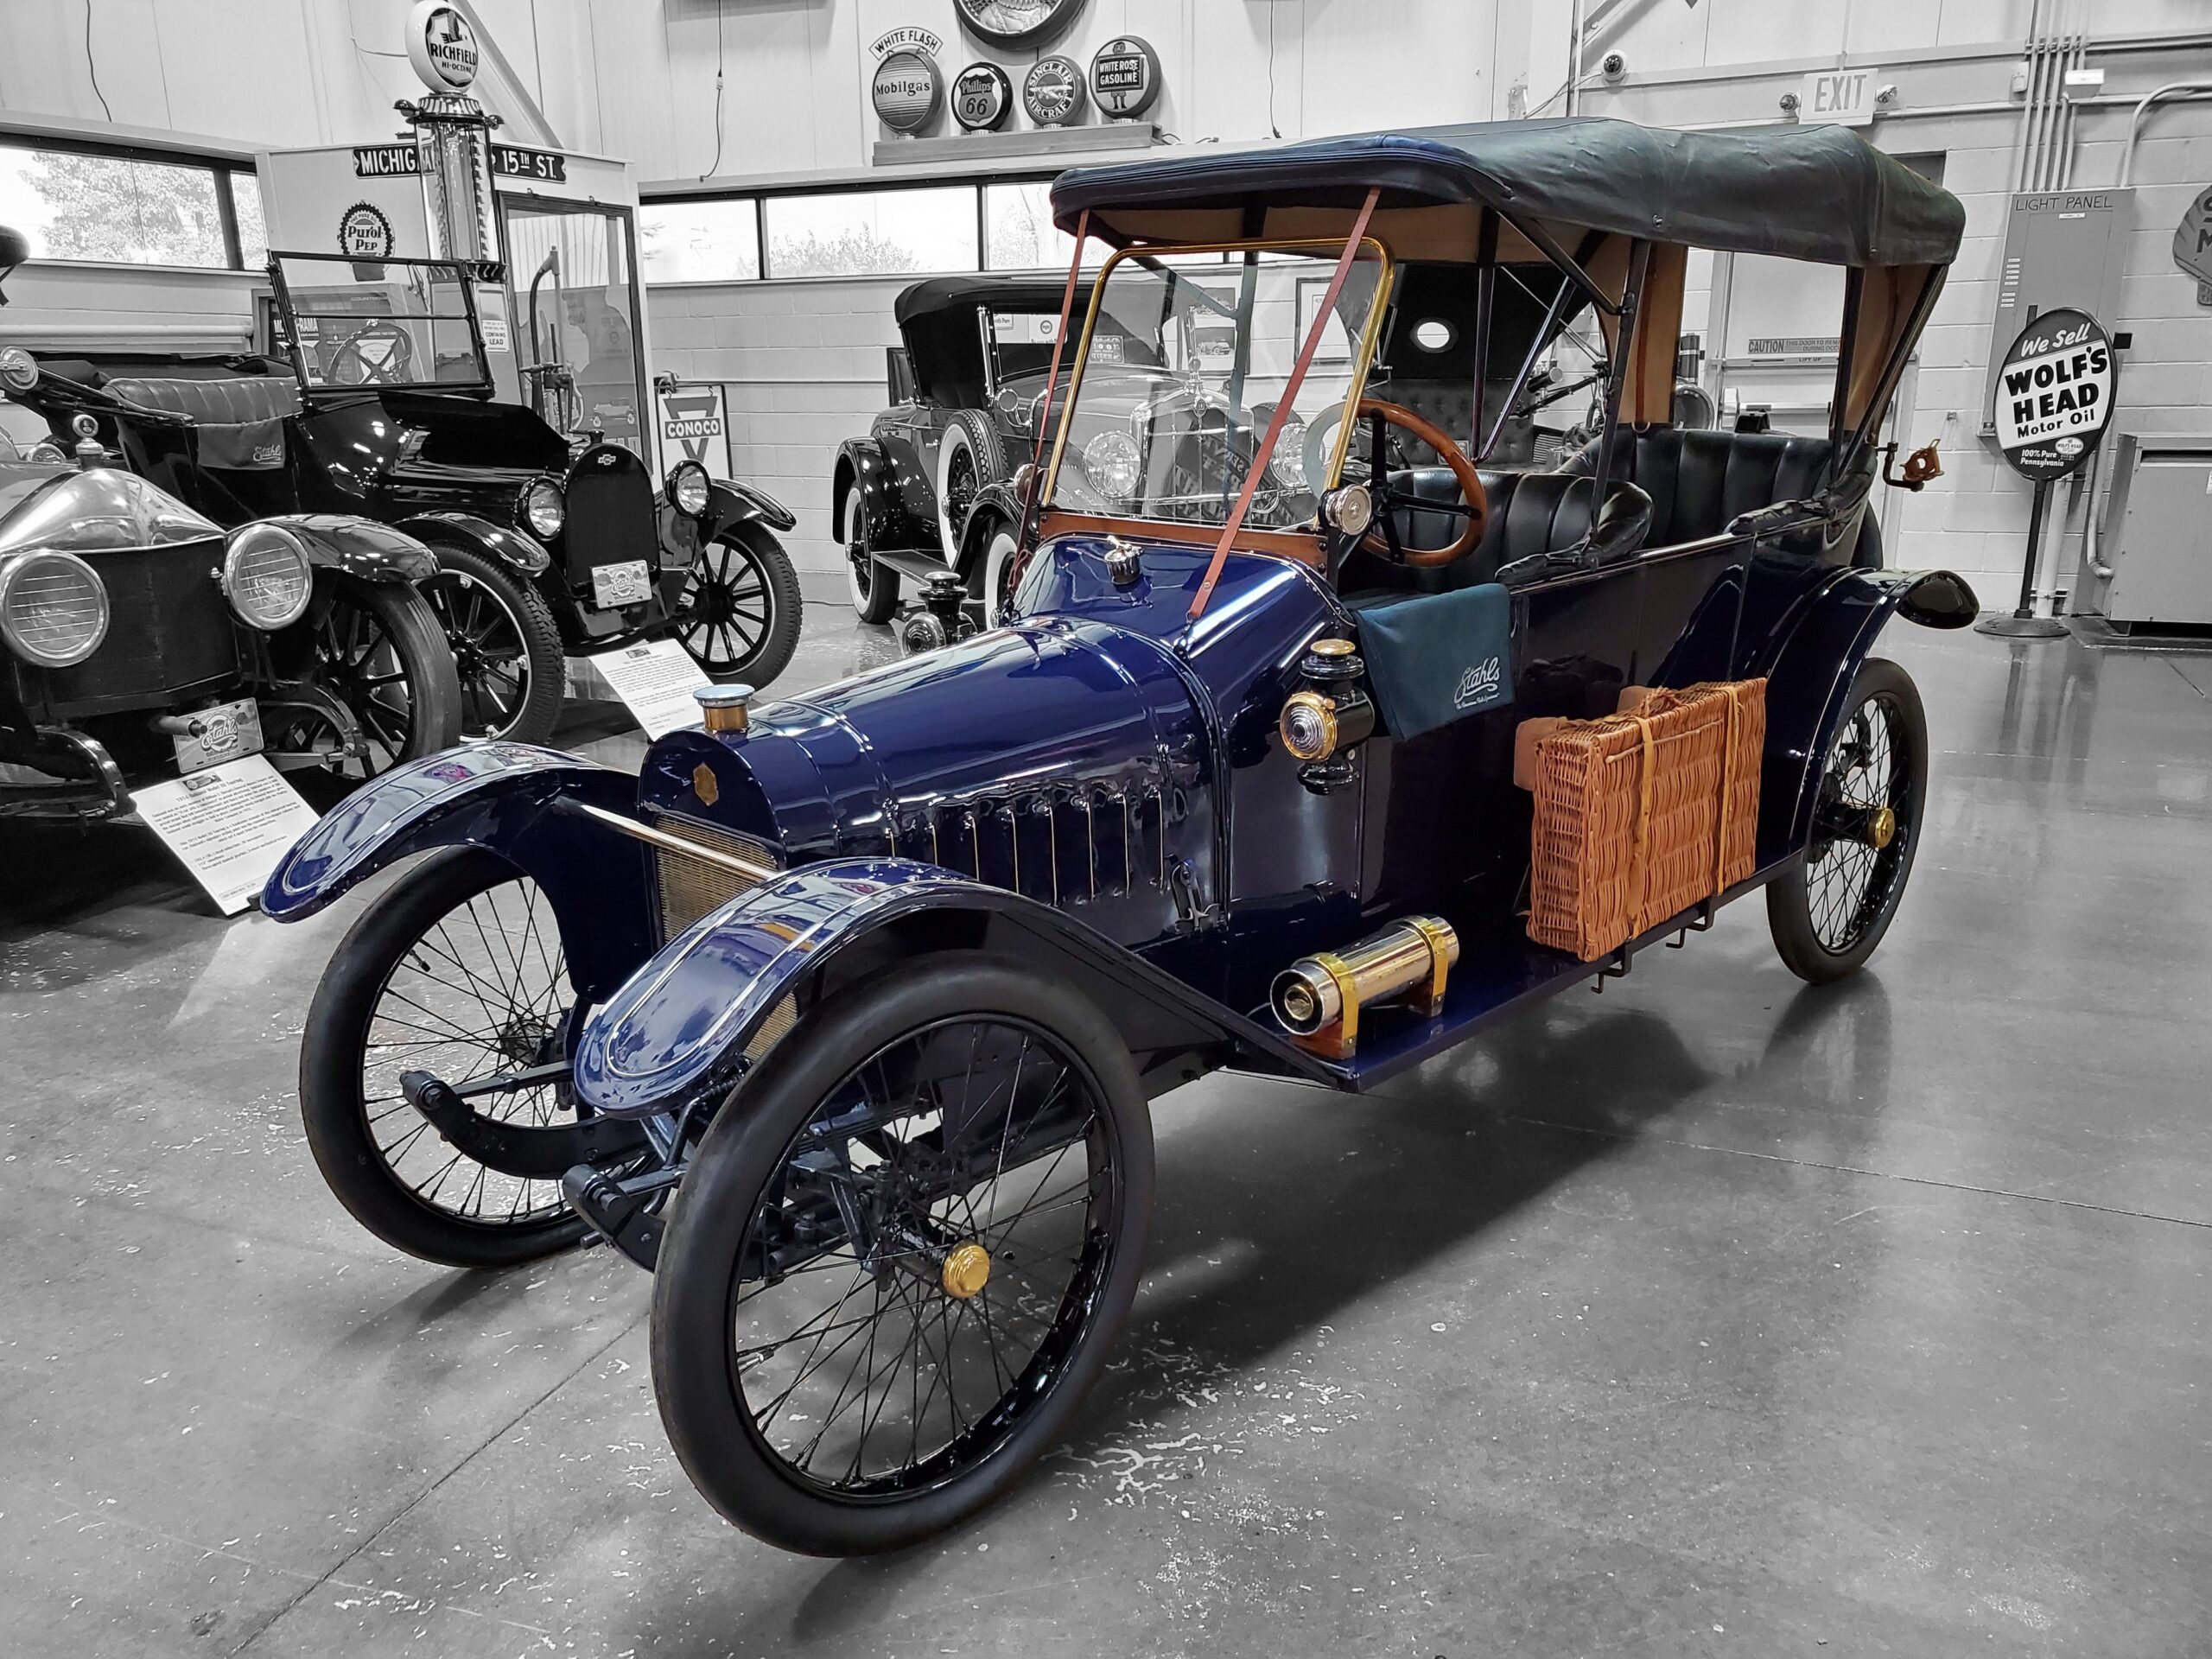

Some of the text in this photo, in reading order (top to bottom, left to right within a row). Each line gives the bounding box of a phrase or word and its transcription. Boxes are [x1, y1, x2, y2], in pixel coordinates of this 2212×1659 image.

[874, 30, 938, 53] WHITE FLASH
[430, 42, 476, 66] RICHFIELD
[1028, 62, 1072, 86] SINCLAIR
[1100, 59, 1139, 73] WHITE ROSE
[961, 79, 992, 93] Phillips
[1099, 72, 1138, 85] GASOLINE
[876, 80, 930, 97] Mobilgas
[1815, 74, 1867, 112] EXIT
[966, 97, 988, 115] 66
[1028, 93, 1072, 118] AIRCRAFT
[2016, 196, 2113, 211] LIGHT PANEL
[1749, 340, 1784, 353] CAUTION
[2021, 322, 2090, 357] We Sell
[2005, 346, 2107, 397] WOLF'S
[2013, 383, 2099, 425] HEAD
[667, 420, 719, 437] CONOCO
[2018, 408, 2094, 439] Motor Oil
[2020, 457, 2064, 468] Pennsylvania
[2022, 448, 2040, 458] 100%
[2041, 450, 2057, 459] Pure
